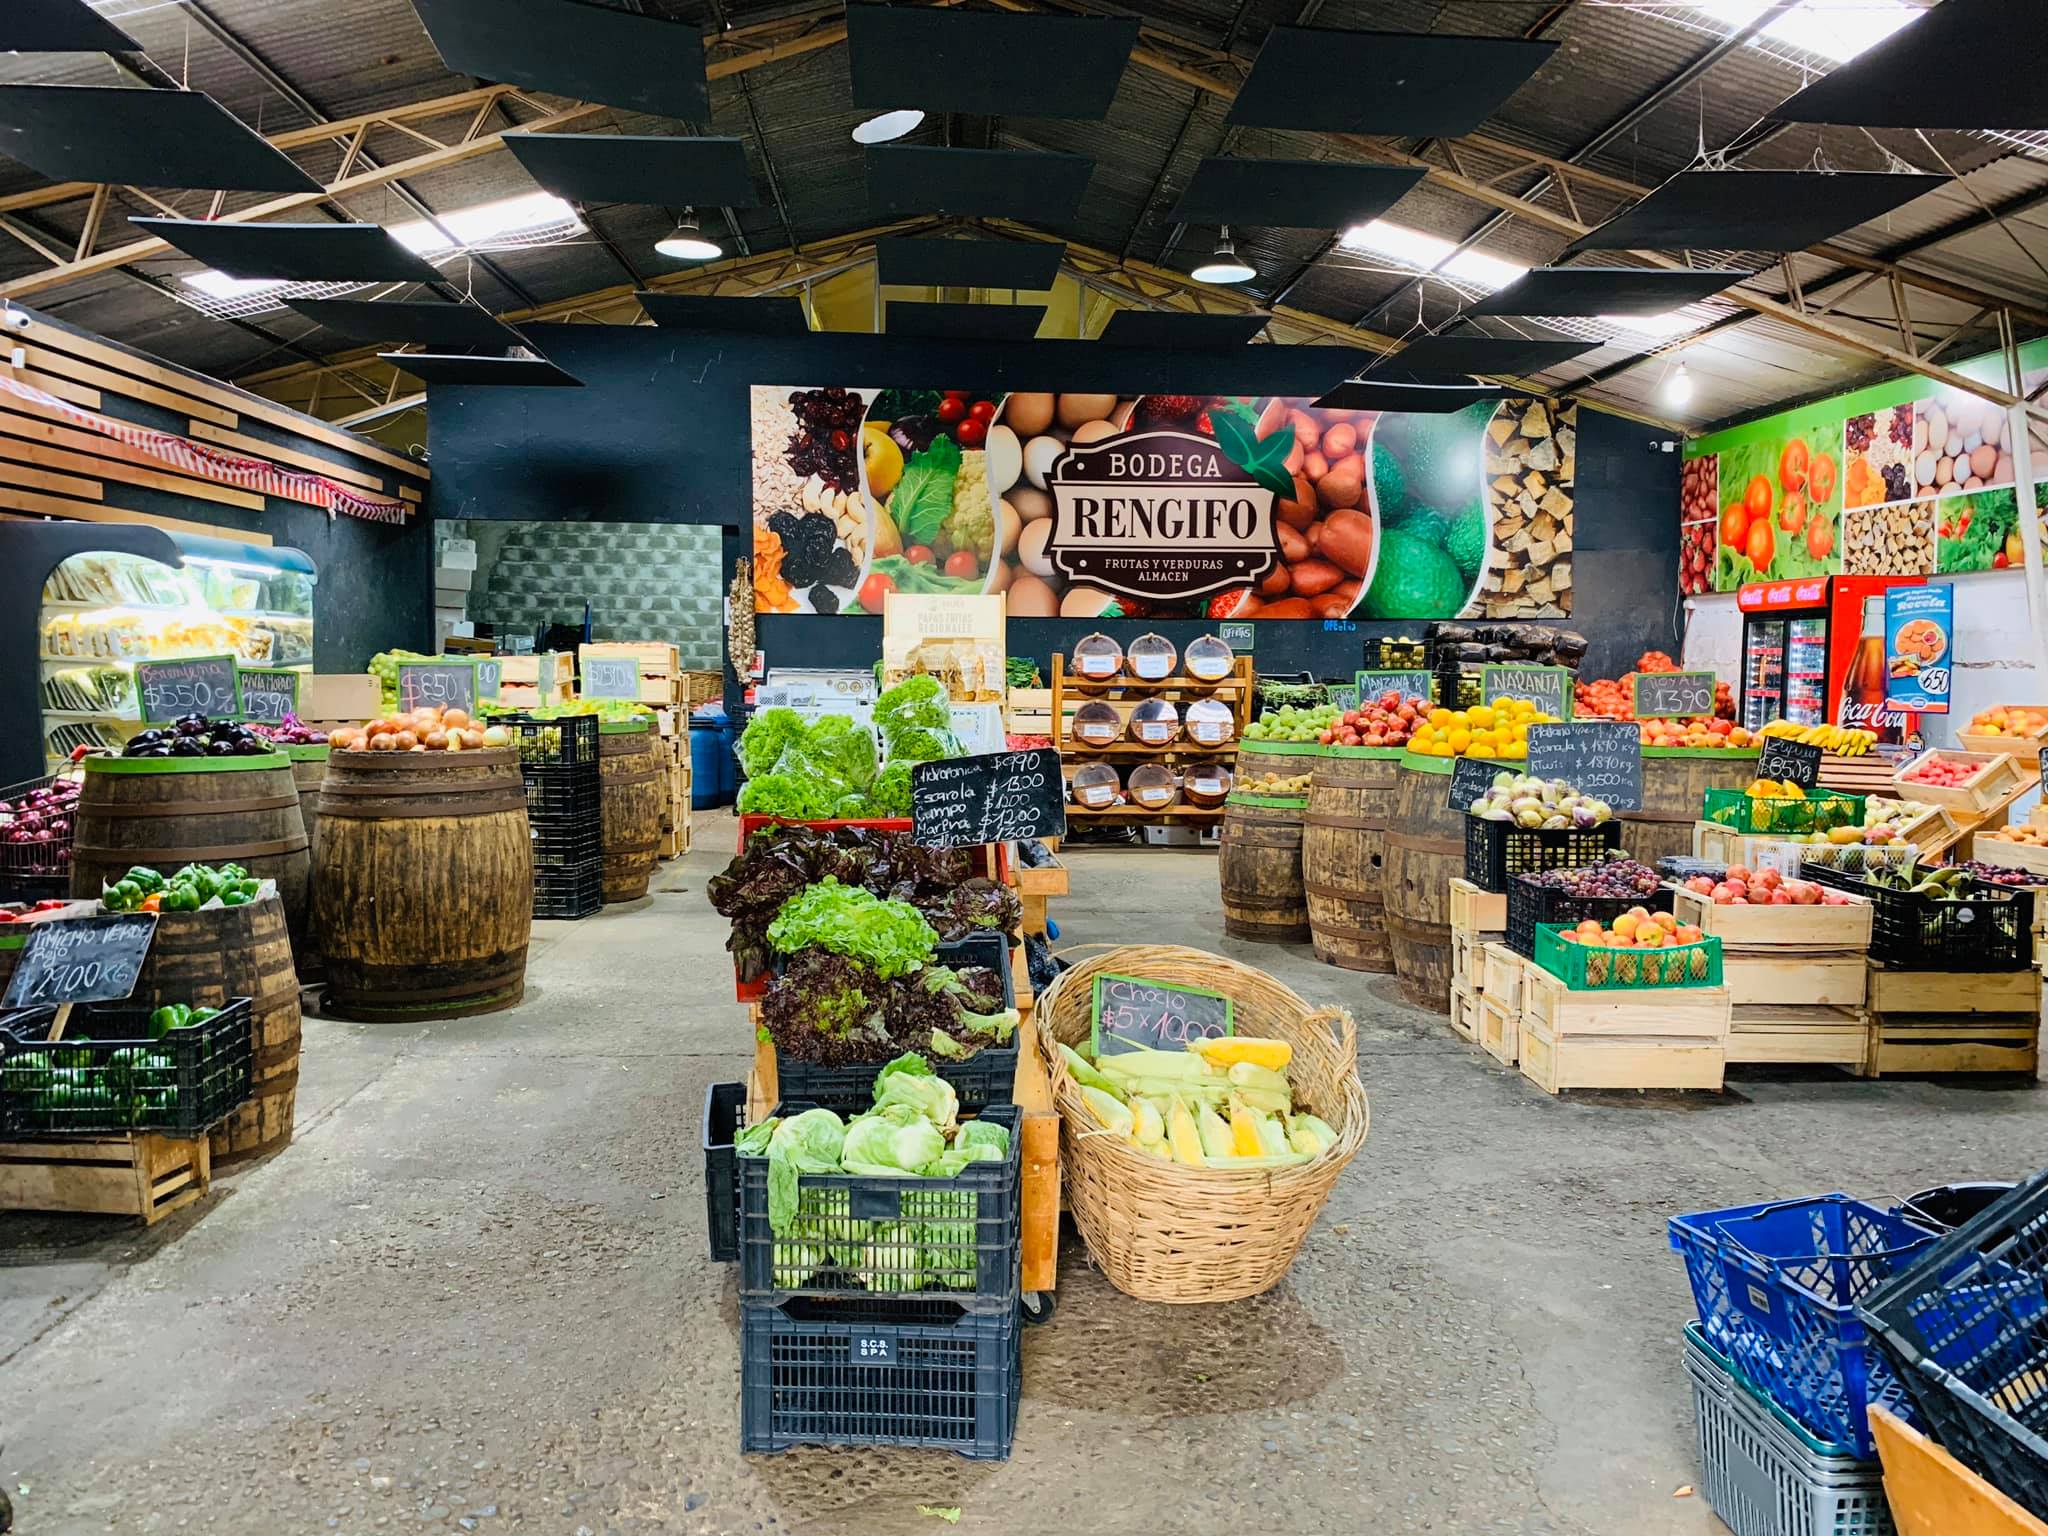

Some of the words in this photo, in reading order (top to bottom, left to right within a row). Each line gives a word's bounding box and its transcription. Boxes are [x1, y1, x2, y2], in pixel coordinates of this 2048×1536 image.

[1108, 453, 1222, 478] BODEGA
[1072, 497, 1258, 540] RENGIFO
[1105, 558, 1150, 570] FRUTAS
[1153, 559, 1163, 570] Y
[1163, 559, 1224, 570] VERDURAS
[1138, 571, 1190, 582] ALMACEN
[1361, 673, 1410, 691] MANZANA
[1493, 669, 1561, 694] NARANJA
[1923, 669, 1949, 692] 650
[144, 681, 212, 713] $550
[1110, 981, 1186, 1010] Choclo
